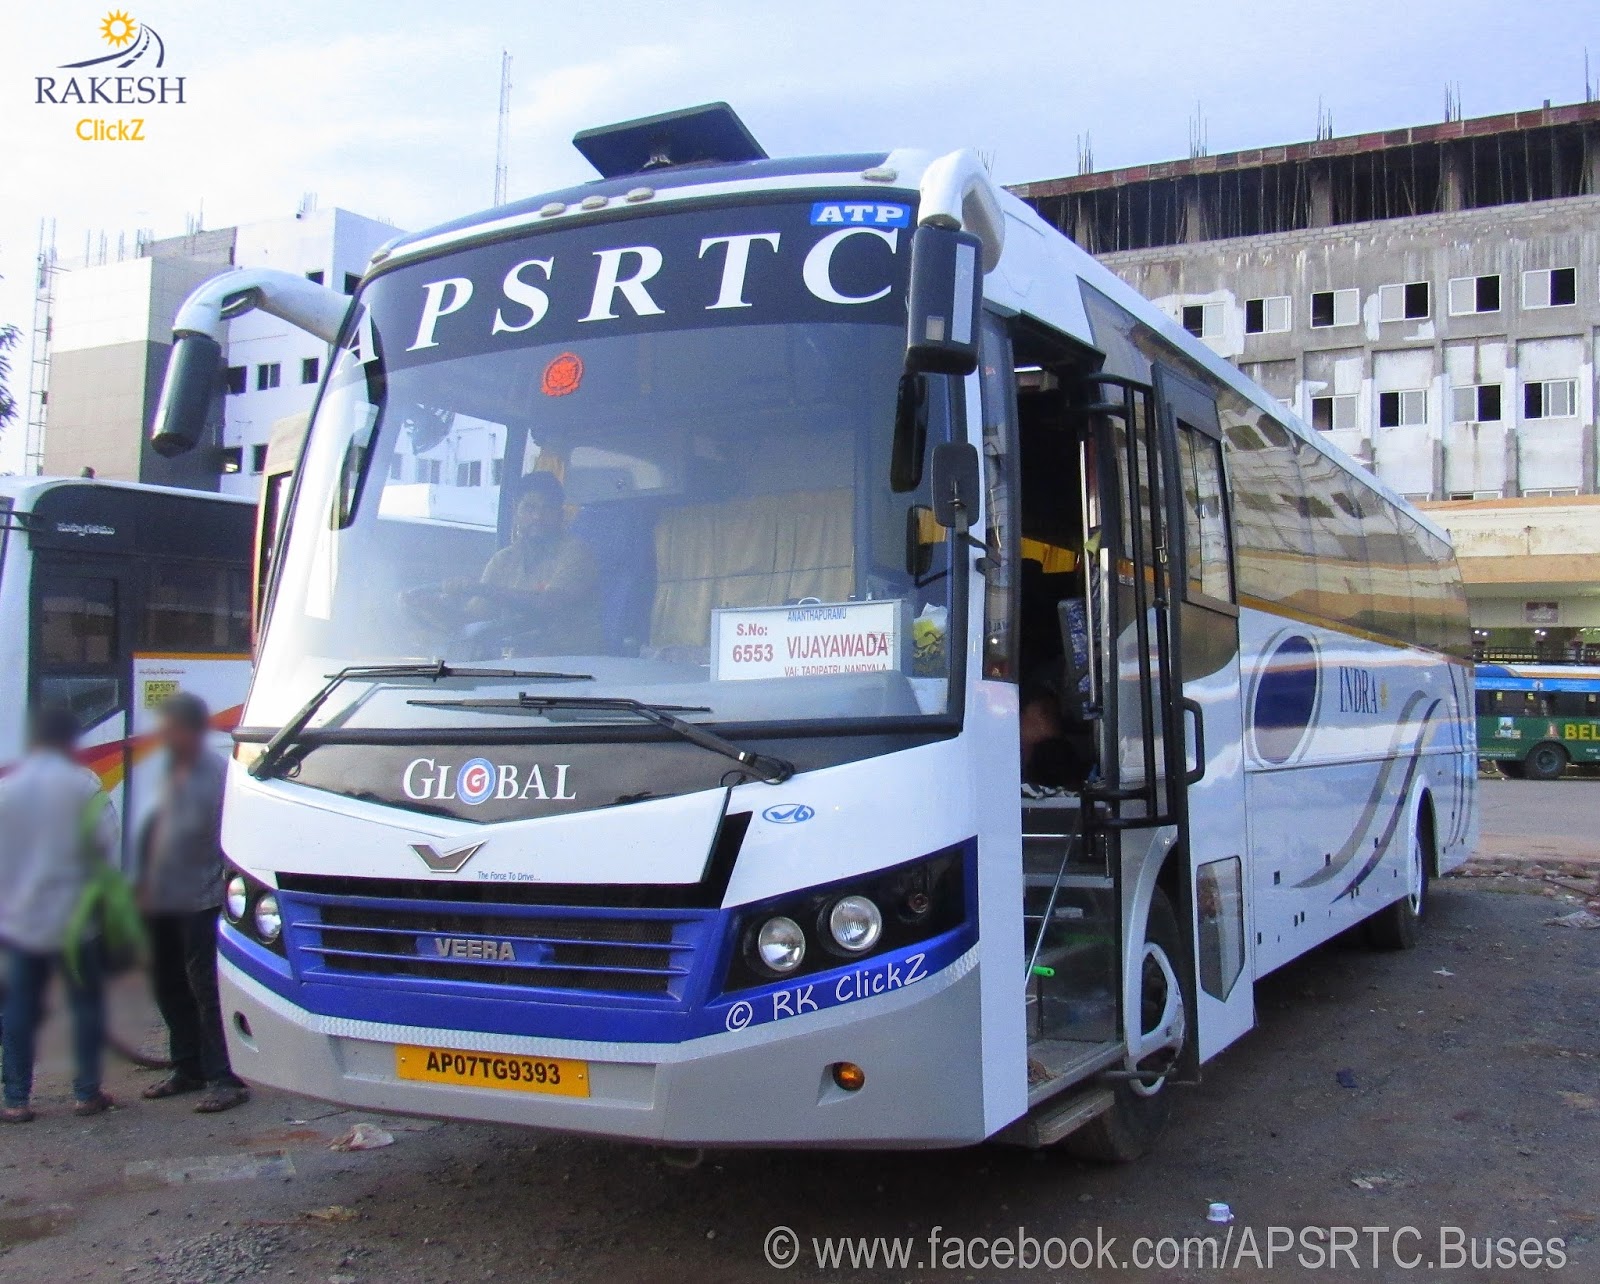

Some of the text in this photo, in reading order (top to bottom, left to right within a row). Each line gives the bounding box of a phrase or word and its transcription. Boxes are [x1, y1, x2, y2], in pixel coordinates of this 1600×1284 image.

[816, 205, 904, 223] ATP
[336, 226, 899, 371] APSRTC
[786, 607, 847, 622] ANANTHAPURAMU
[736, 623, 768, 637] S.No:
[732, 632, 889, 663] 6553 VIJAYAWADA
[1339, 665, 1378, 714] INDRA
[477, 871, 489, 880] The
[490, 871, 507, 880] Force
[508, 872, 517, 881] To
[435, 938, 517, 961] VEERA
[426, 1051, 561, 1085] AP07TG9393
